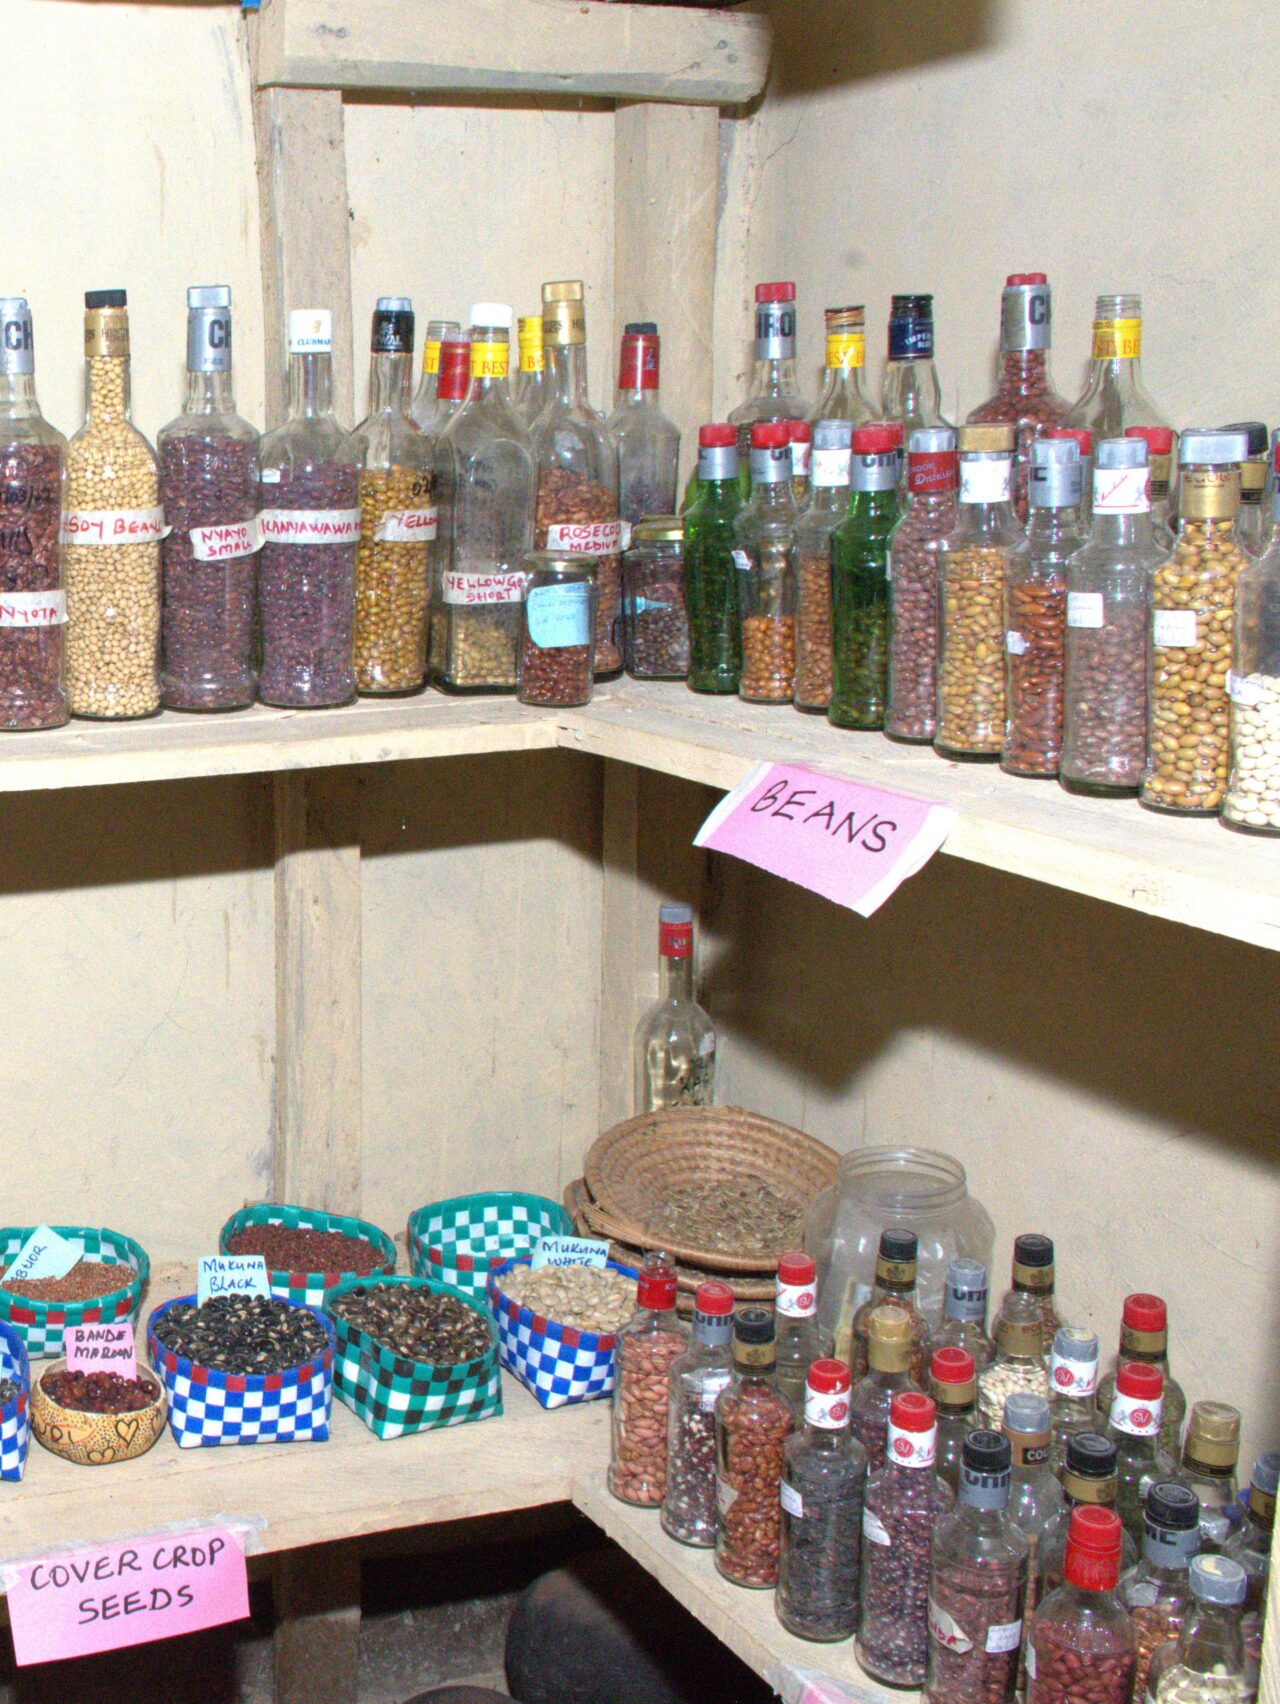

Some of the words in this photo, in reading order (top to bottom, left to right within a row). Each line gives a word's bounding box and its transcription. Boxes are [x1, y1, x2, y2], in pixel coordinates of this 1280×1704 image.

[750, 779, 898, 853] BEANS
[203, 1258, 264, 1273] MUKUNA
[209, 1275, 257, 1294] BLACK
[29, 1549, 143, 1591] COVER
[152, 1537, 226, 1571] CROP
[78, 1584, 195, 1626] SEEDS
